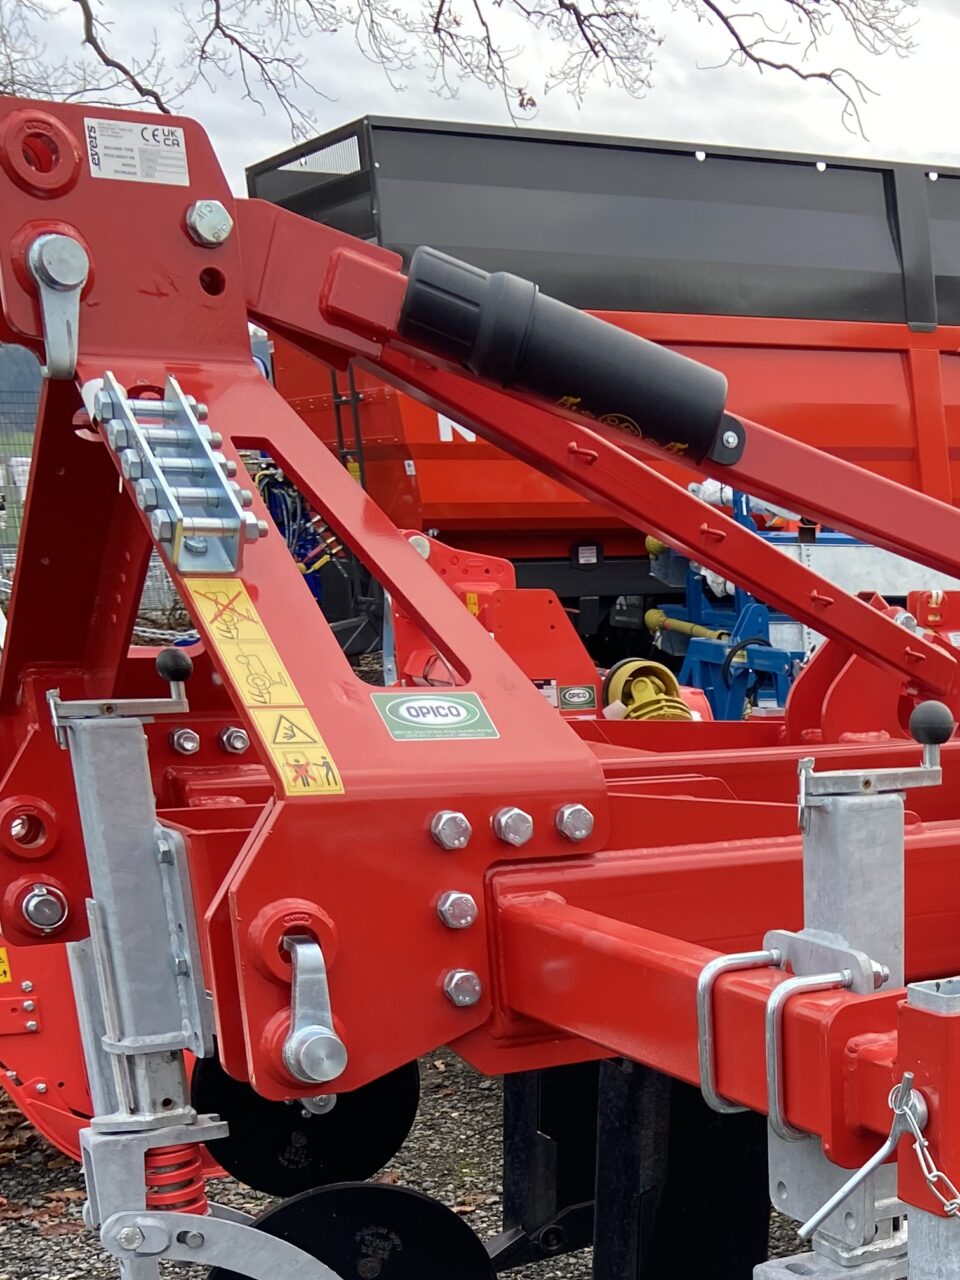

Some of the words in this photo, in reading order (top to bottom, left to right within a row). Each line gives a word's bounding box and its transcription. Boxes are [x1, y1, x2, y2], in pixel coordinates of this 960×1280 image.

[162, 128, 177, 138] UK
[87, 125, 101, 171] evers
[163, 138, 180, 147] CA
[405, 705, 461, 719] OPICO
